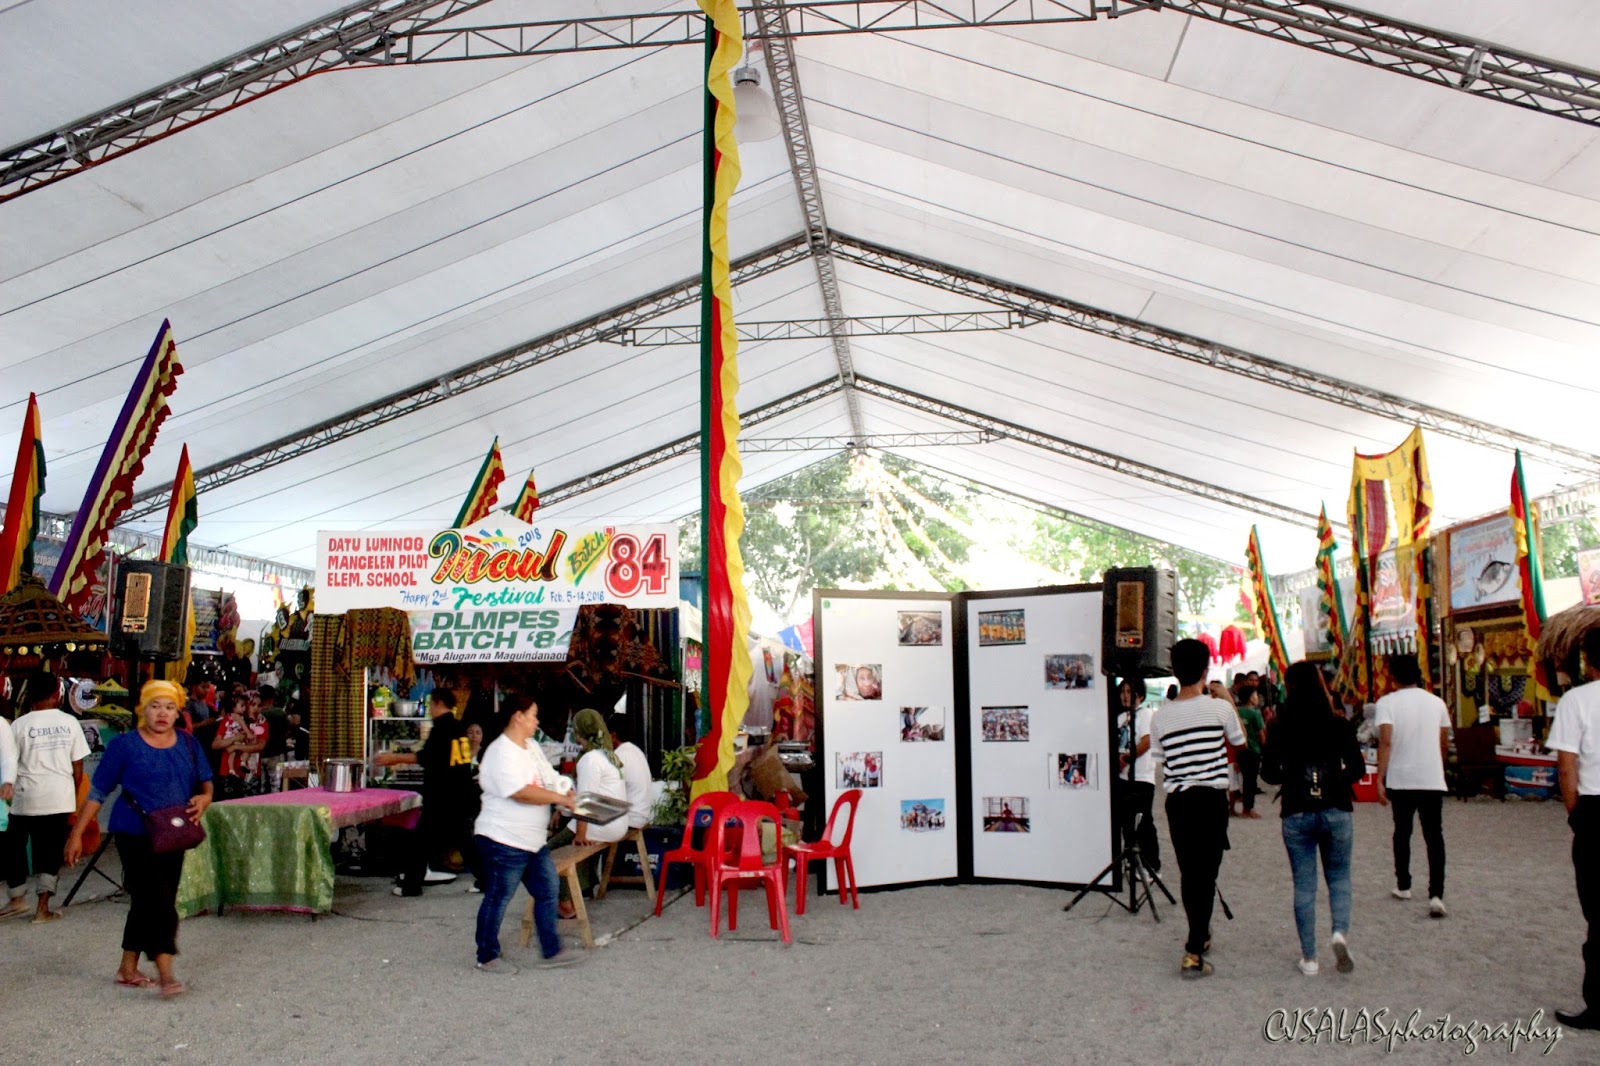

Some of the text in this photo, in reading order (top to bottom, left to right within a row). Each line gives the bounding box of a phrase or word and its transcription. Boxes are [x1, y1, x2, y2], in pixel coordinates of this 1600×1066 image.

[328, 537, 424, 552] DATU LUMINOG
[518, 528, 542, 547] 2018
[567, 531, 605, 575] Batch
[399, 554, 429, 569] PILOT
[327, 571, 417, 587] ELEM. SCHOOL
[399, 590, 430, 607] Happy
[431, 588, 450, 606] 2nd
[451, 585, 545, 611] Festival
[431, 610, 560, 630] DLMPES
[413, 631, 518, 650] BATCH
[443, 651, 477, 663] Alugan
[479, 652, 491, 661] na
[28, 726, 72, 739] CEBUANA
[624, 853, 660, 863] PESI
